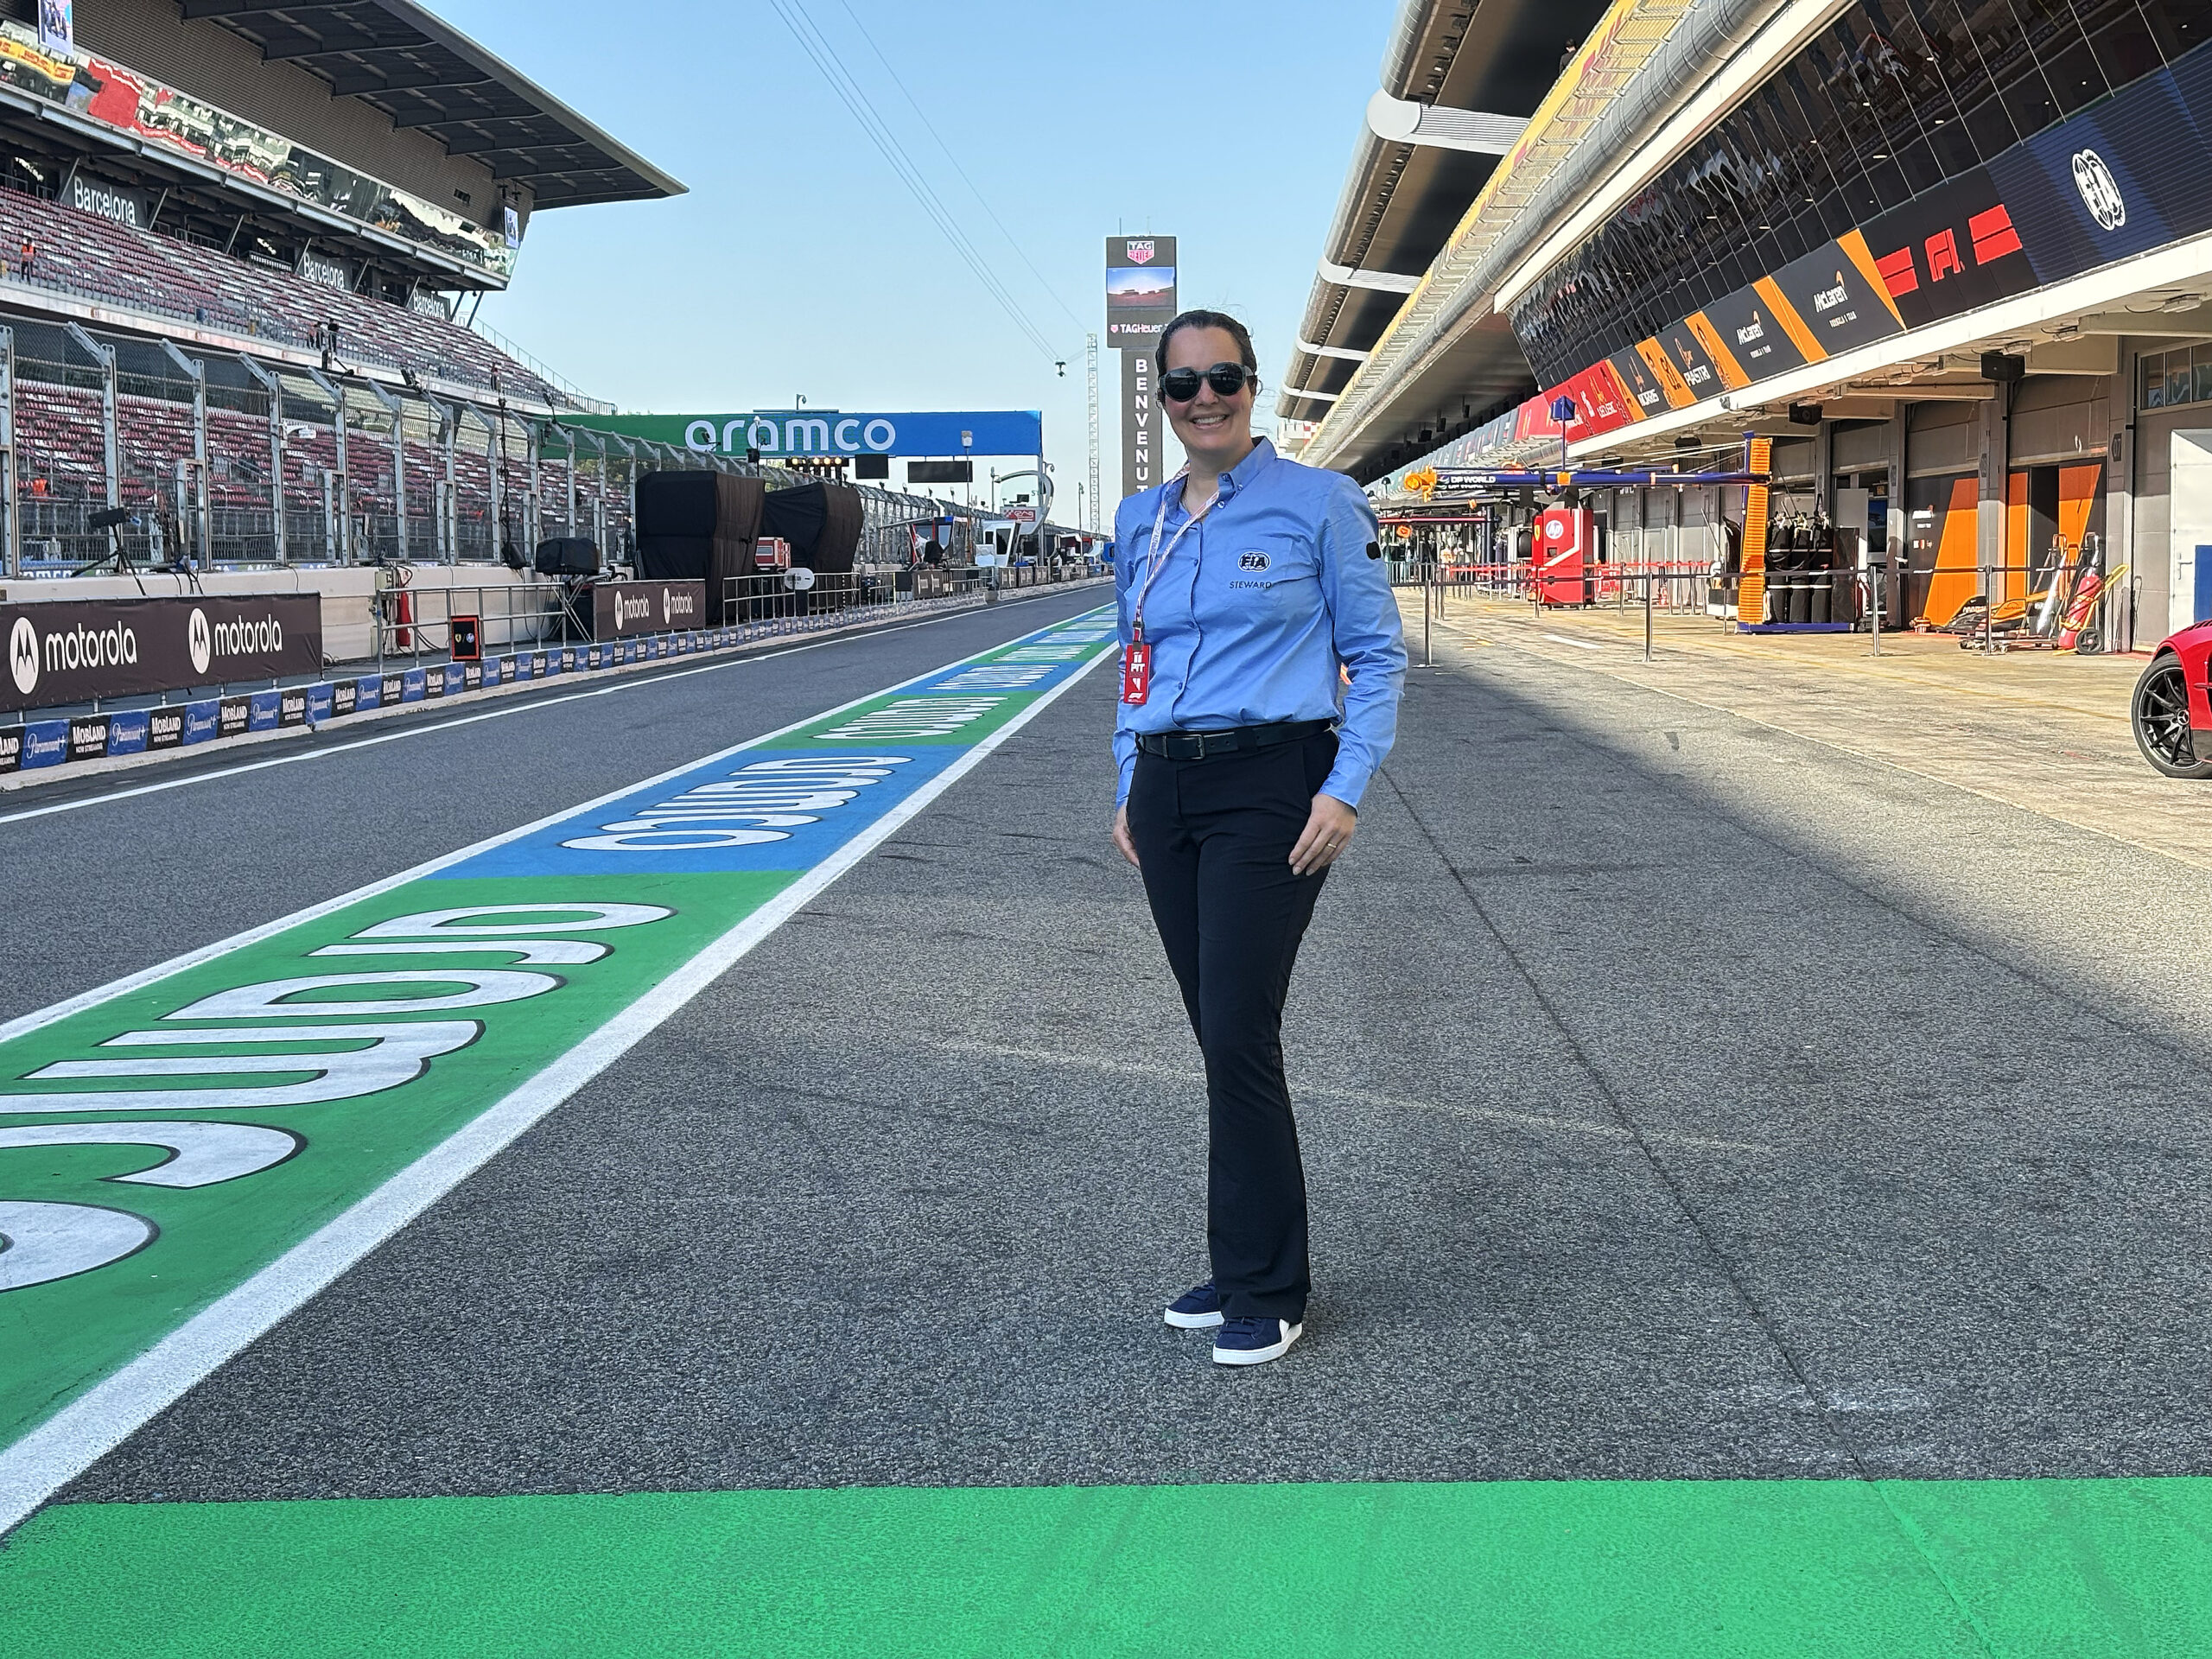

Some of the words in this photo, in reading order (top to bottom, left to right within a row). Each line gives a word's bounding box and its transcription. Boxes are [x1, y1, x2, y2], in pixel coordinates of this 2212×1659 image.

[74, 175, 137, 226] Barcelona
[303, 253, 345, 290] Barcelona
[413, 289, 445, 319] Barcelona
[1814, 285, 1848, 313] McLaren
[1736, 323, 1764, 345] McLaren
[685, 419, 895, 452] aramco
[1241, 556, 1267, 568] FIA
[1230, 581, 1272, 589] STEWARD
[624, 594, 650, 620] motorola
[46, 620, 137, 671] motorola
[215, 613, 283, 656] motorola
[1131, 664, 1146, 672] PIT
